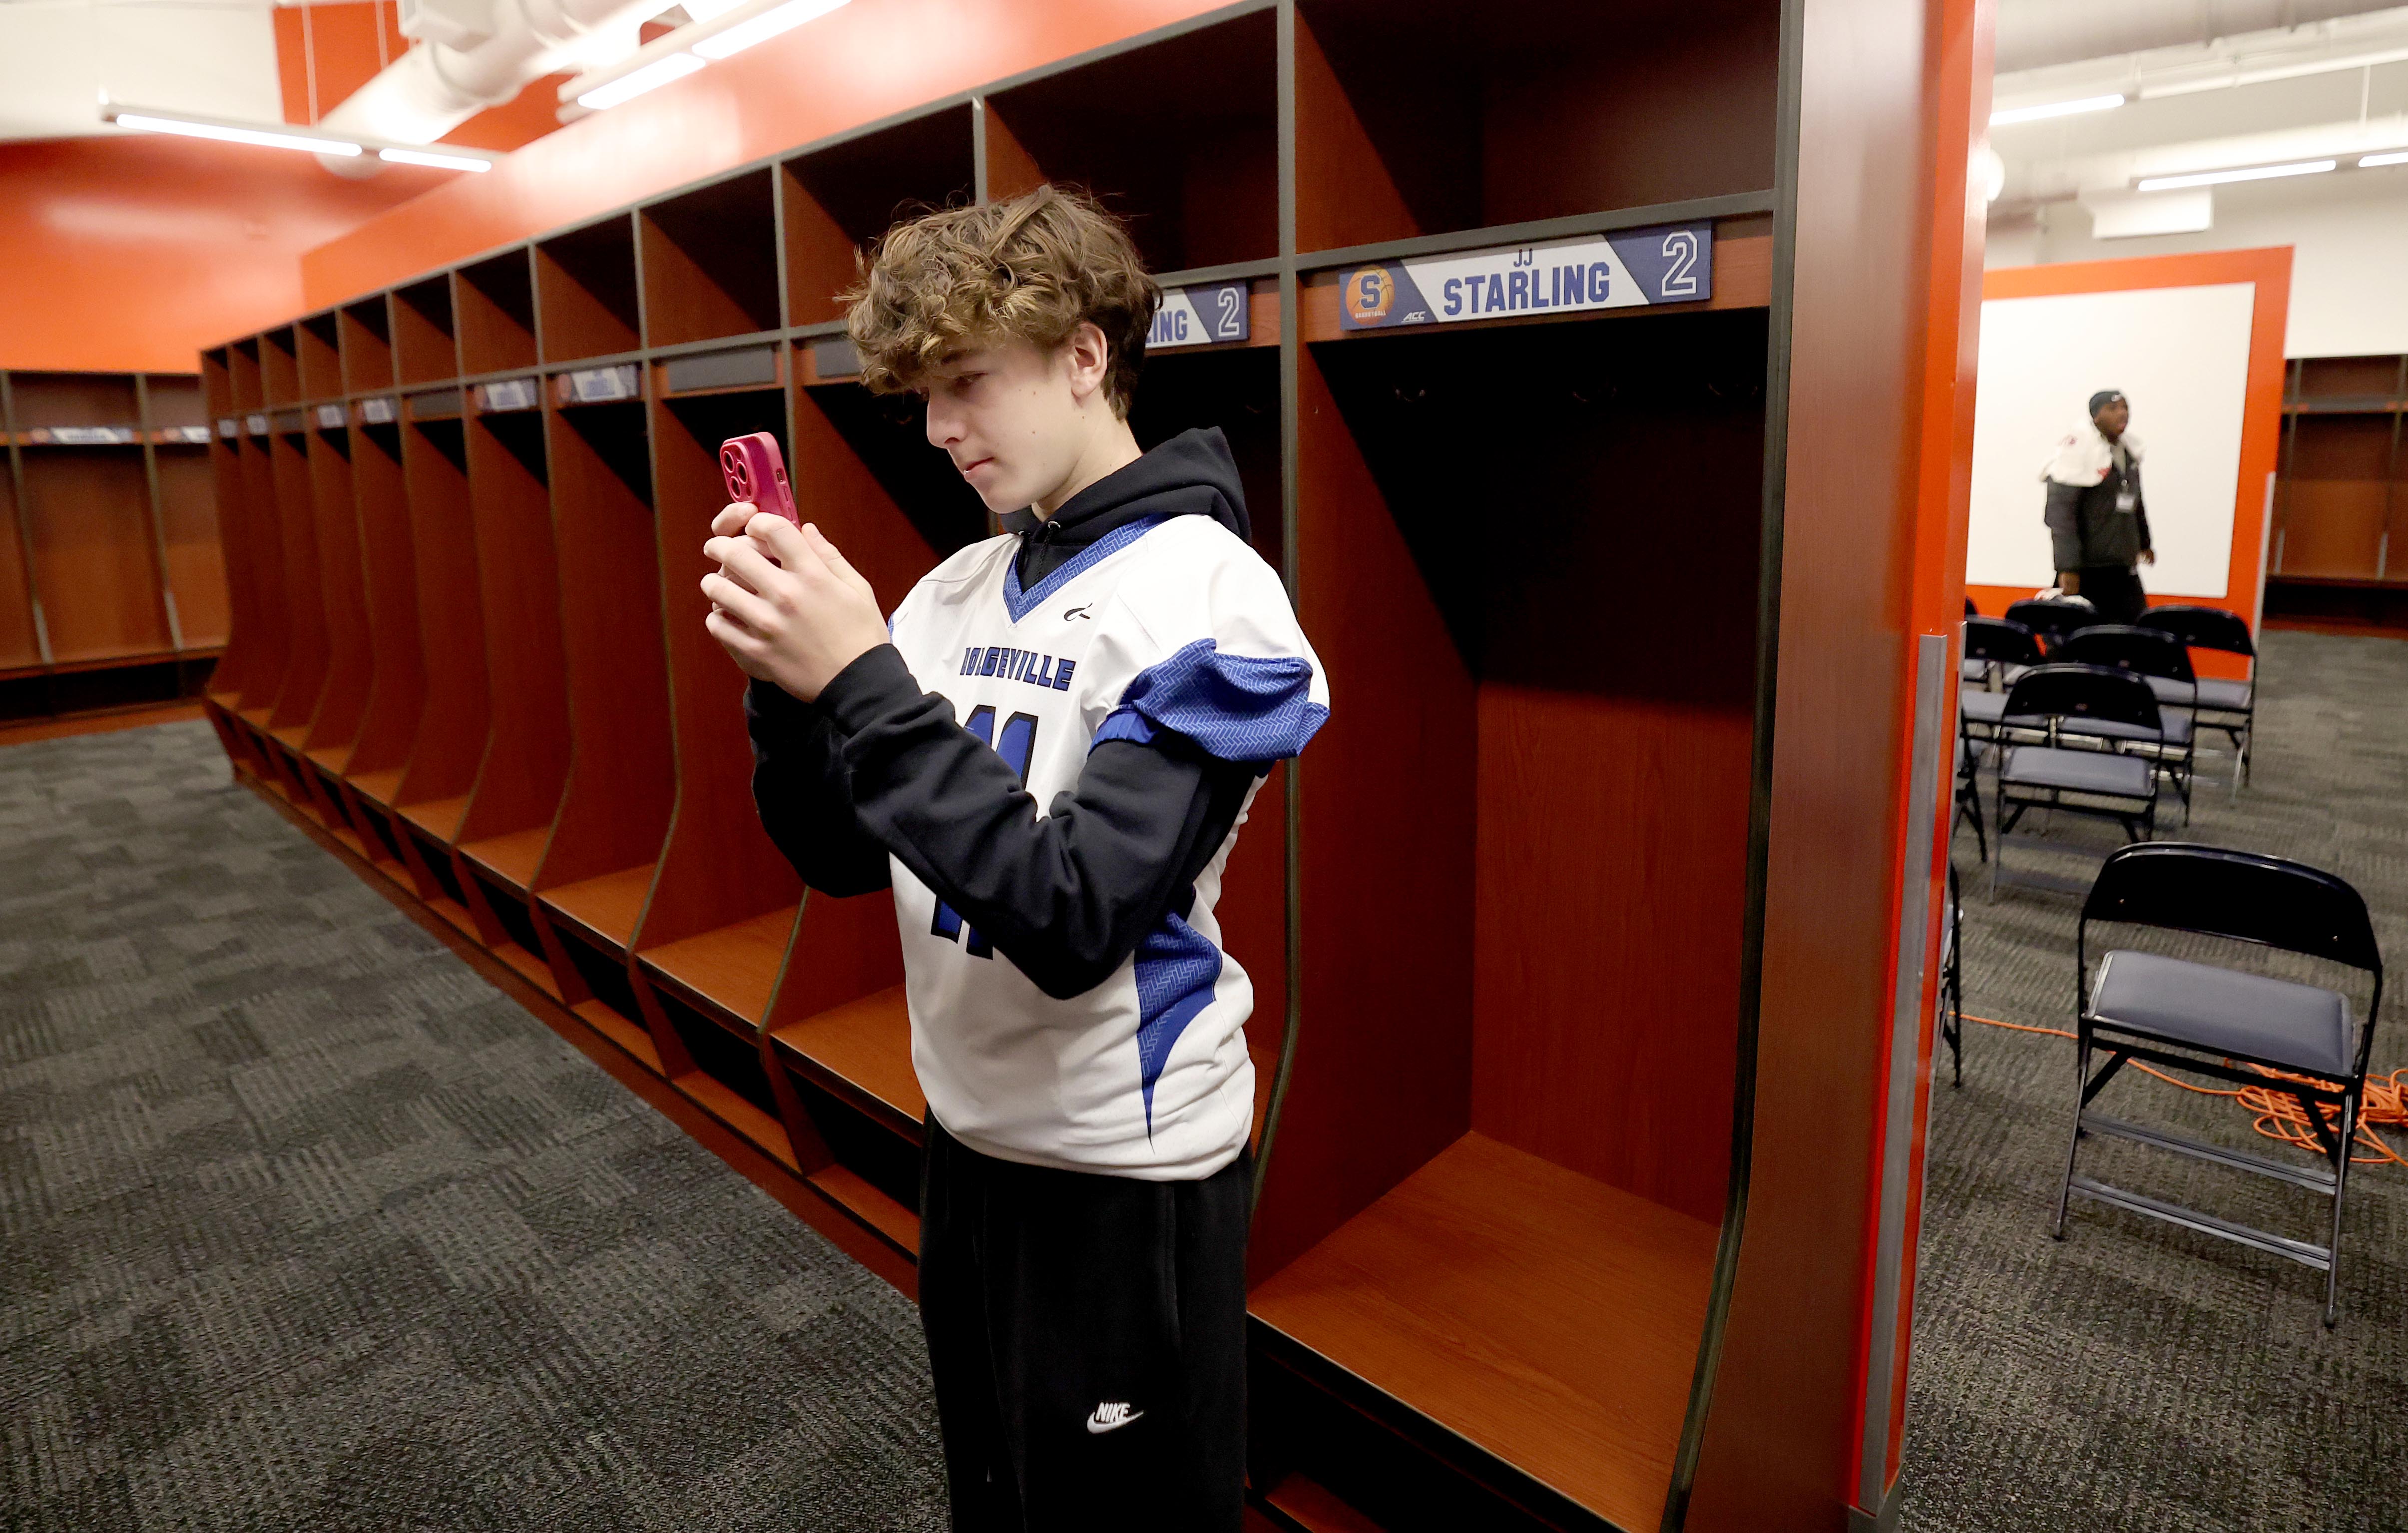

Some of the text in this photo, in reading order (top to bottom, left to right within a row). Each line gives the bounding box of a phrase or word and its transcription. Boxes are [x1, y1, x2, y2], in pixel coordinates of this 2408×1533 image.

[1513, 248, 1533, 267] JJ
[1662, 230, 1697, 297] 2
[1360, 273, 1382, 310] S
[1444, 262, 1609, 316] STARLING
[1146, 309, 1188, 344] ING
[1218, 287, 1240, 337] 2
[1402, 311, 1426, 322] ACC
[1095, 1402, 1131, 1423] NIKE
